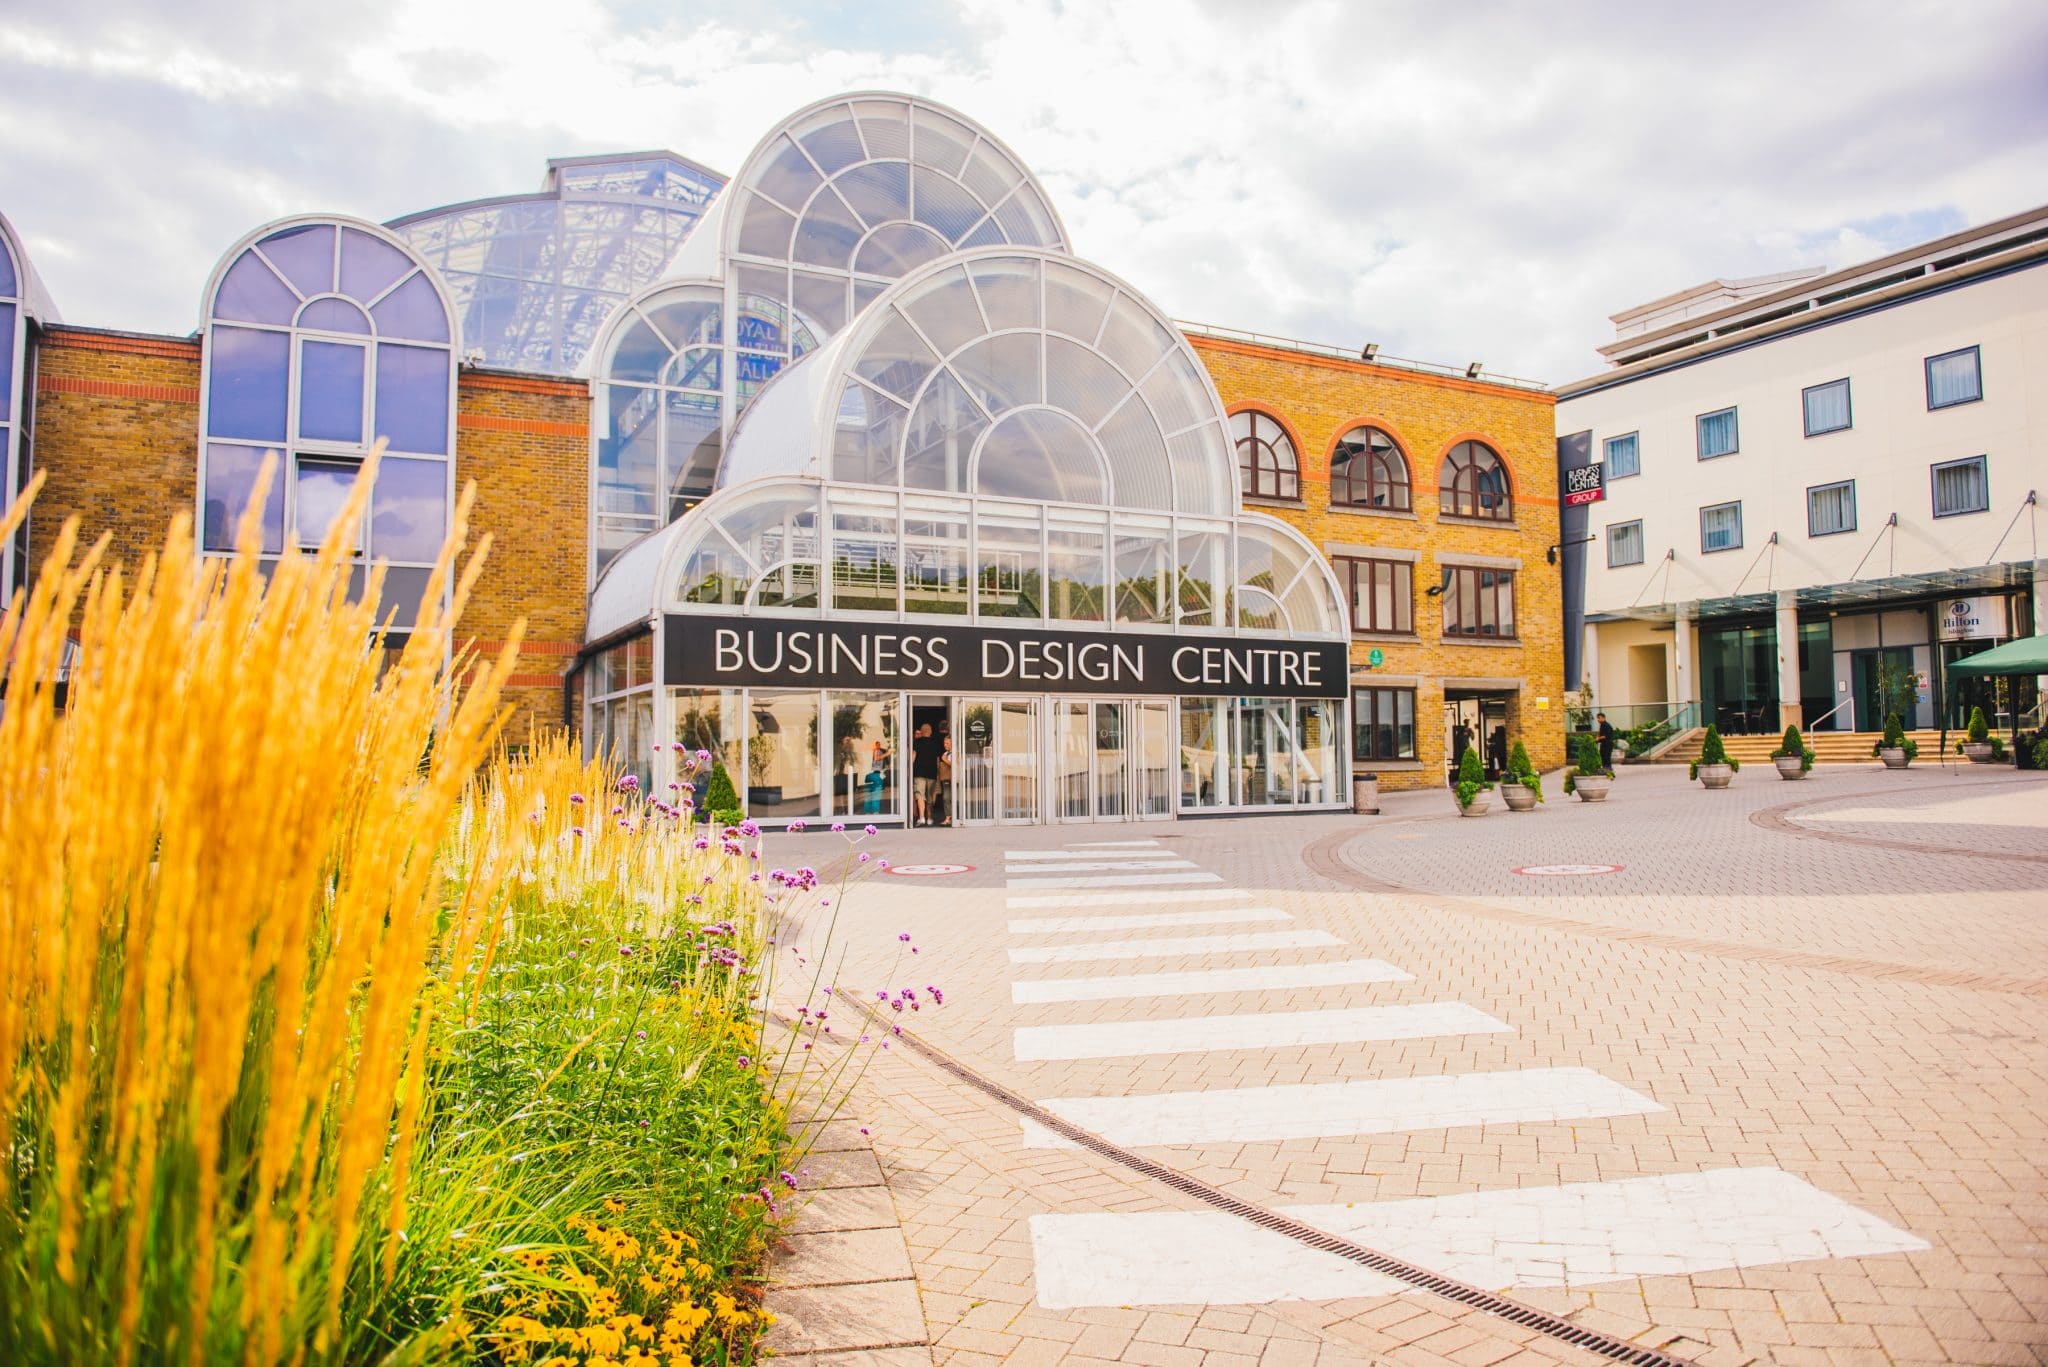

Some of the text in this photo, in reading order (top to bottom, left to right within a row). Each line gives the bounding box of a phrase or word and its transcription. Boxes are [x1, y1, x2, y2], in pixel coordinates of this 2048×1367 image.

[1572, 492, 1597, 504] GROUP
[1944, 616, 1979, 628] Hilton
[715, 628, 1322, 687] BUSINESS DESIGN CENTRE
